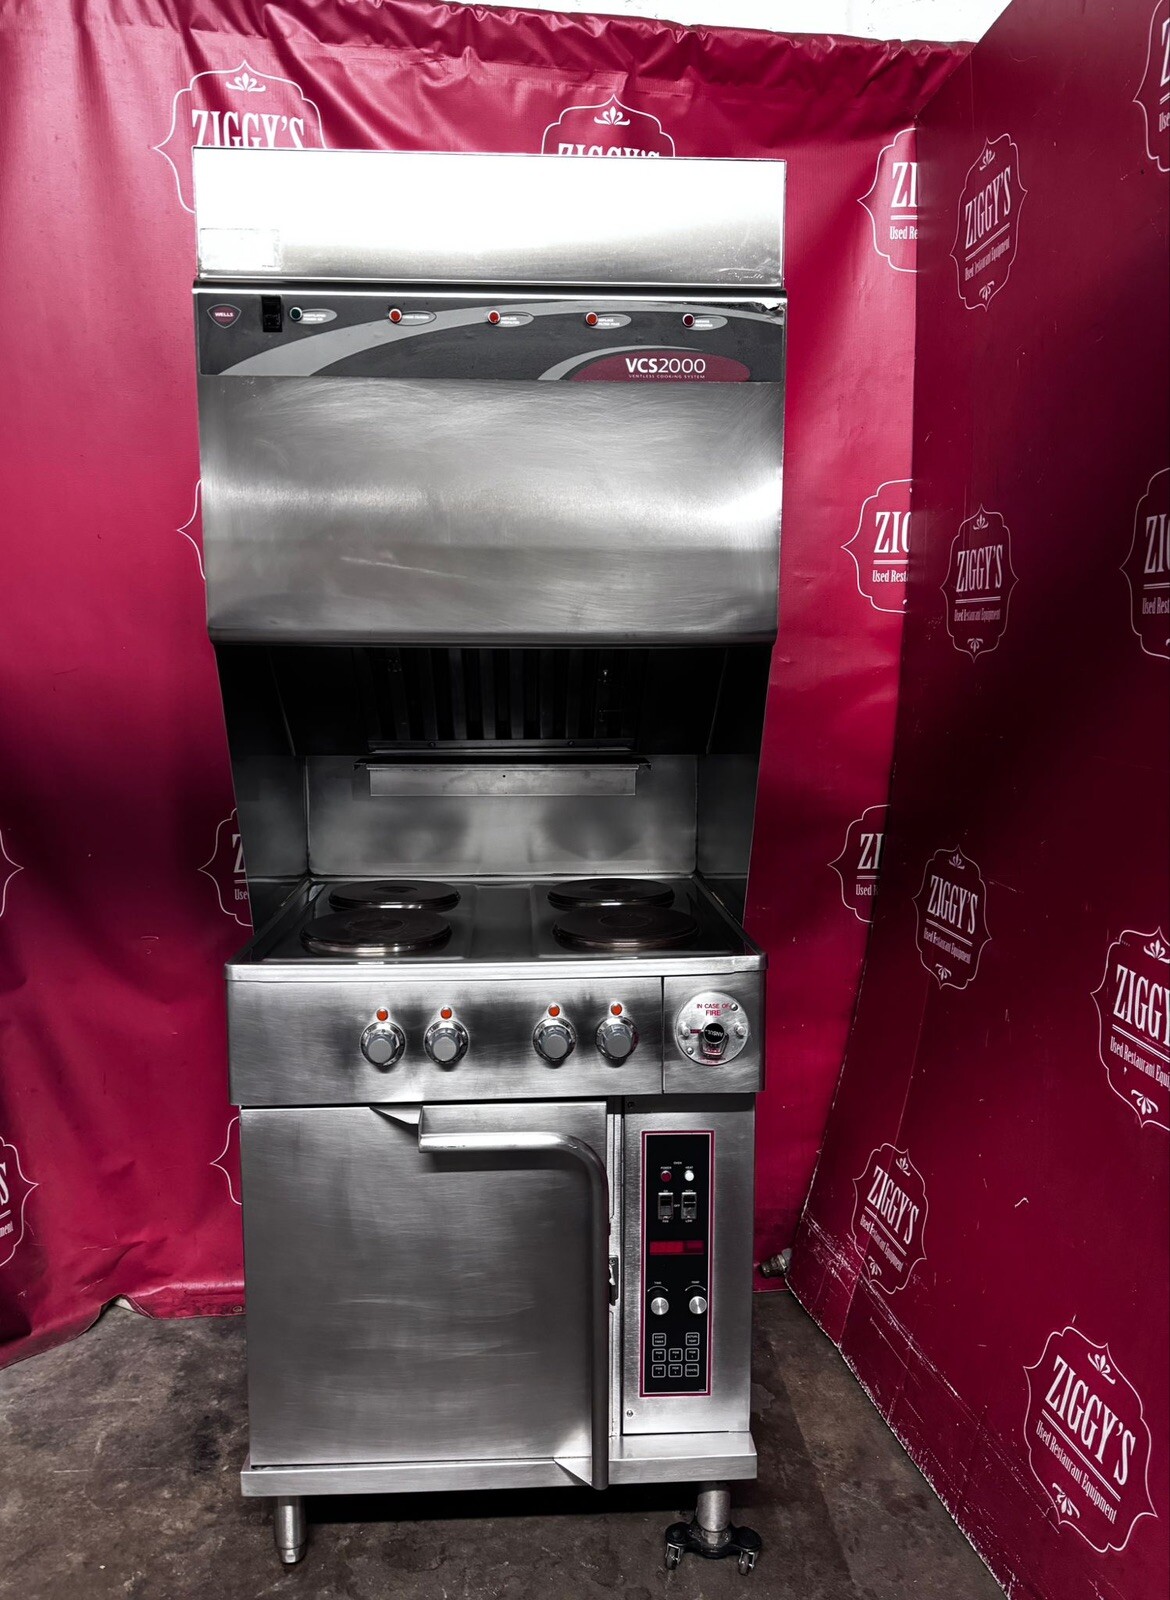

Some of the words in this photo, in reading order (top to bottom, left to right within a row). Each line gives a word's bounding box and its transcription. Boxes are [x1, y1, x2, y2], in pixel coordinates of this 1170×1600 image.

[965, 165, 1011, 250] ZIGGY'S
[890, 225, 908, 240] Used
[625, 357, 706, 374] VCS2000
[872, 569, 890, 583] Used
[956, 544, 1003, 592] ZIGGY'S
[855, 884, 872, 896] Used
[927, 875, 978, 935] ZIGGY'S
[1110, 1035, 1124, 1058] Used
[867, 1165, 919, 1245] ZIGGY'S
[1045, 1355, 1136, 1486] ZIGGY'S
[1036, 1419, 1052, 1447] Used
[1049, 1435, 1083, 1484] Restaurant
[1081, 1472, 1117, 1525] Equipment
